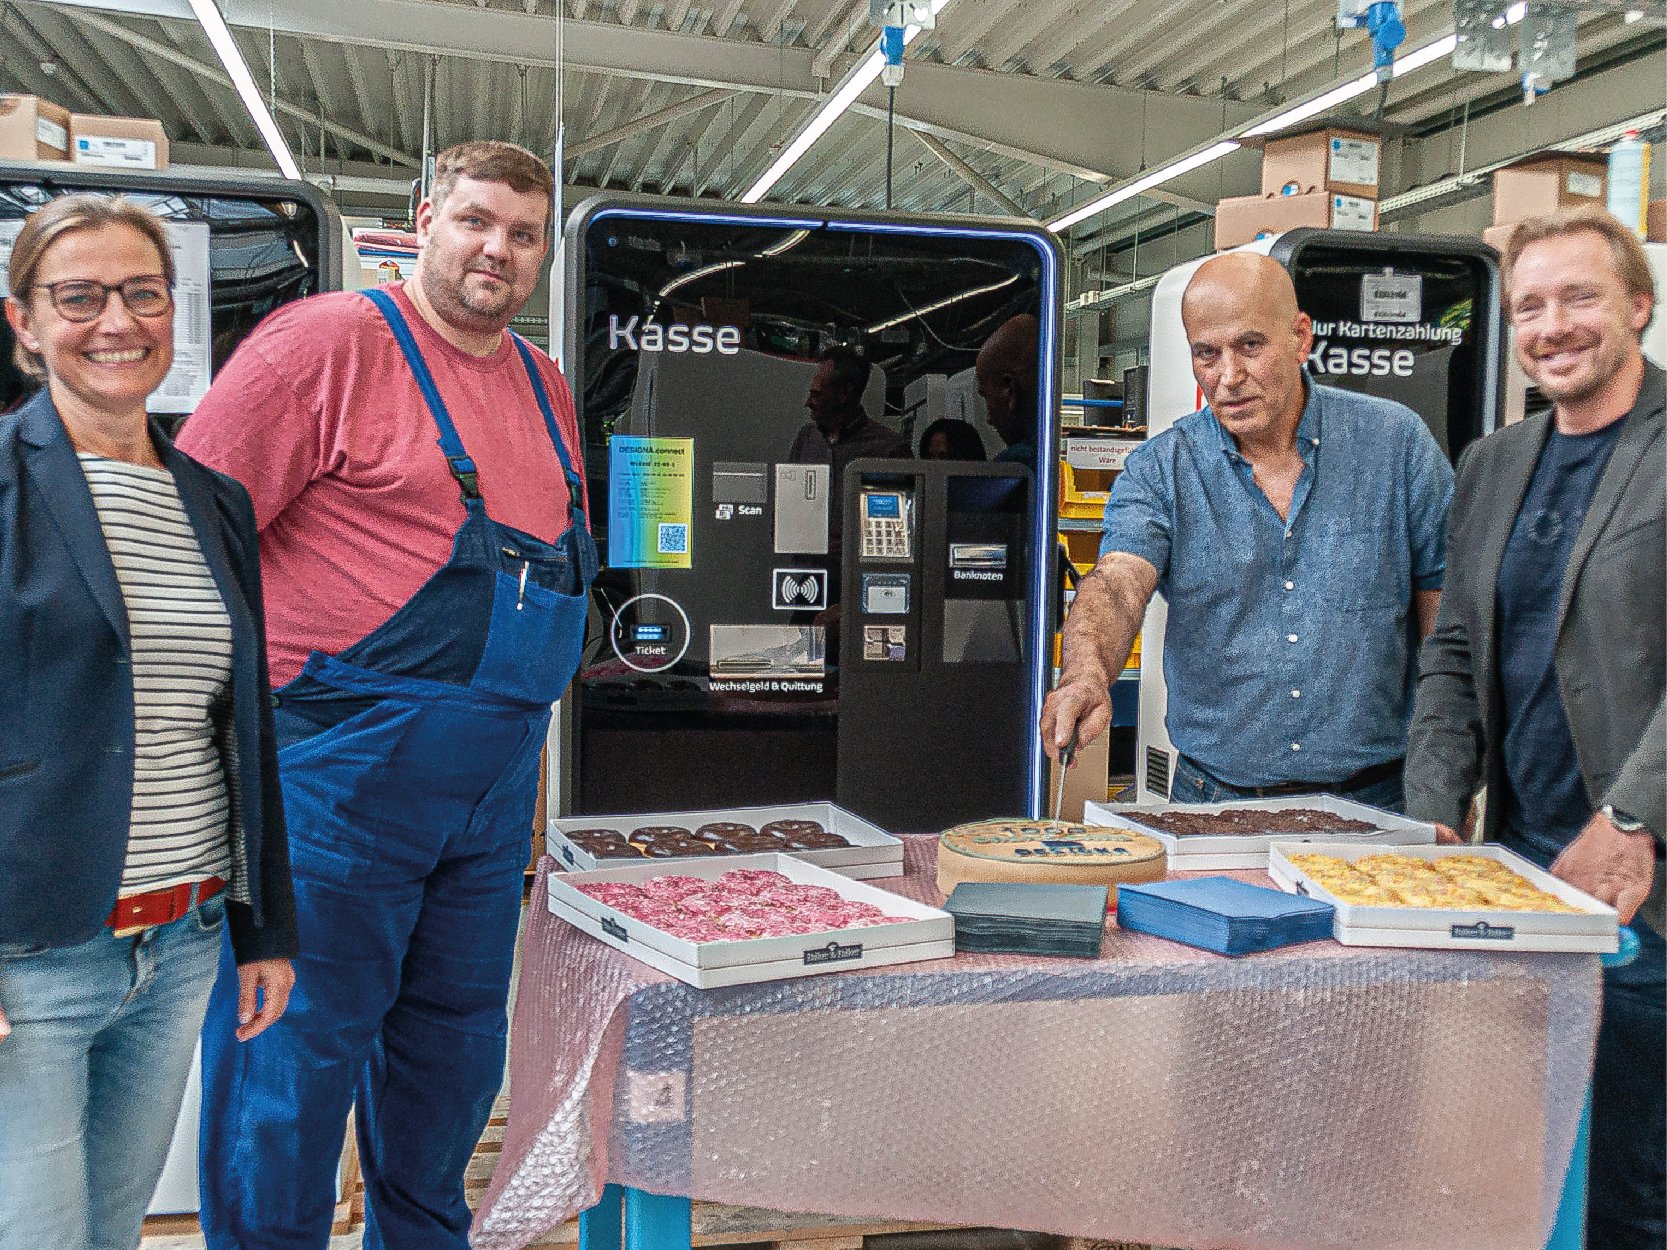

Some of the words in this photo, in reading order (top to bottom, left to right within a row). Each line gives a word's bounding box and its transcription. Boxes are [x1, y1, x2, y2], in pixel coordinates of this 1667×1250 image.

[609, 314, 740, 355] Kasse
[1339, 321, 1462, 346] Kartenzahlung
[738, 505, 762, 515] Scan
[954, 570, 1003, 581] Banknoten
[635, 645, 666, 655] Ticket
[709, 681, 770, 692] Wechselgeld
[771, 681, 779, 690] &
[781, 682, 823, 693] Quittung
